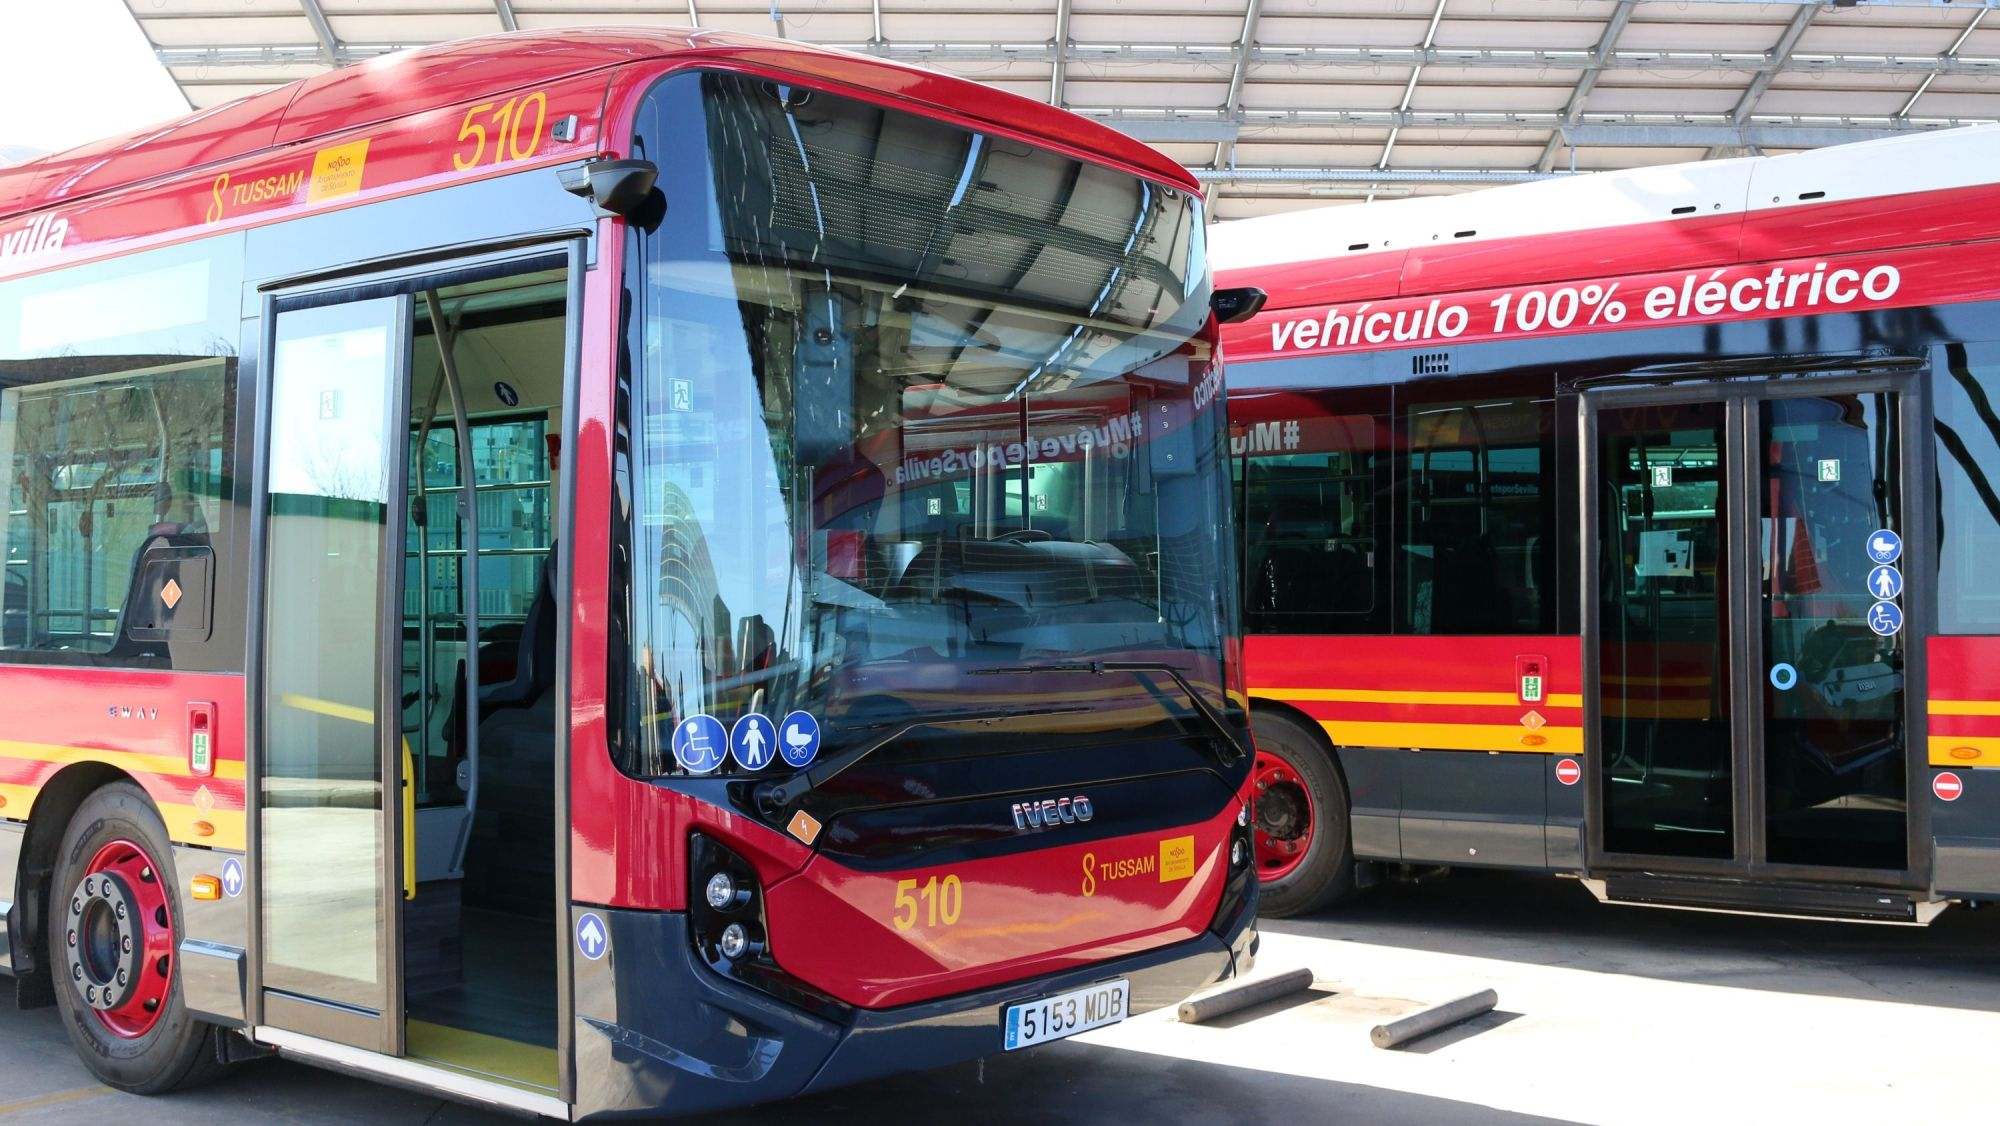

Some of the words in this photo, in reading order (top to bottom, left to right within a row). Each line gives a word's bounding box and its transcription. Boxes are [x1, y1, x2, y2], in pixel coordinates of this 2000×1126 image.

[453, 92, 547, 172] 510
[232, 170, 304, 207] TUSSAM
[0, 211, 69, 258] villa
[1271, 300, 1469, 351] vehículo
[1490, 282, 1627, 333] 100%
[1644, 262, 1900, 320] eléctrico
[1012, 796, 1093, 829] IVECO
[1100, 855, 1155, 881] TUSSAM
[893, 874, 962, 932] 510
[1024, 999, 1077, 1040] 5153
[1084, 988, 1122, 1024] MDB
